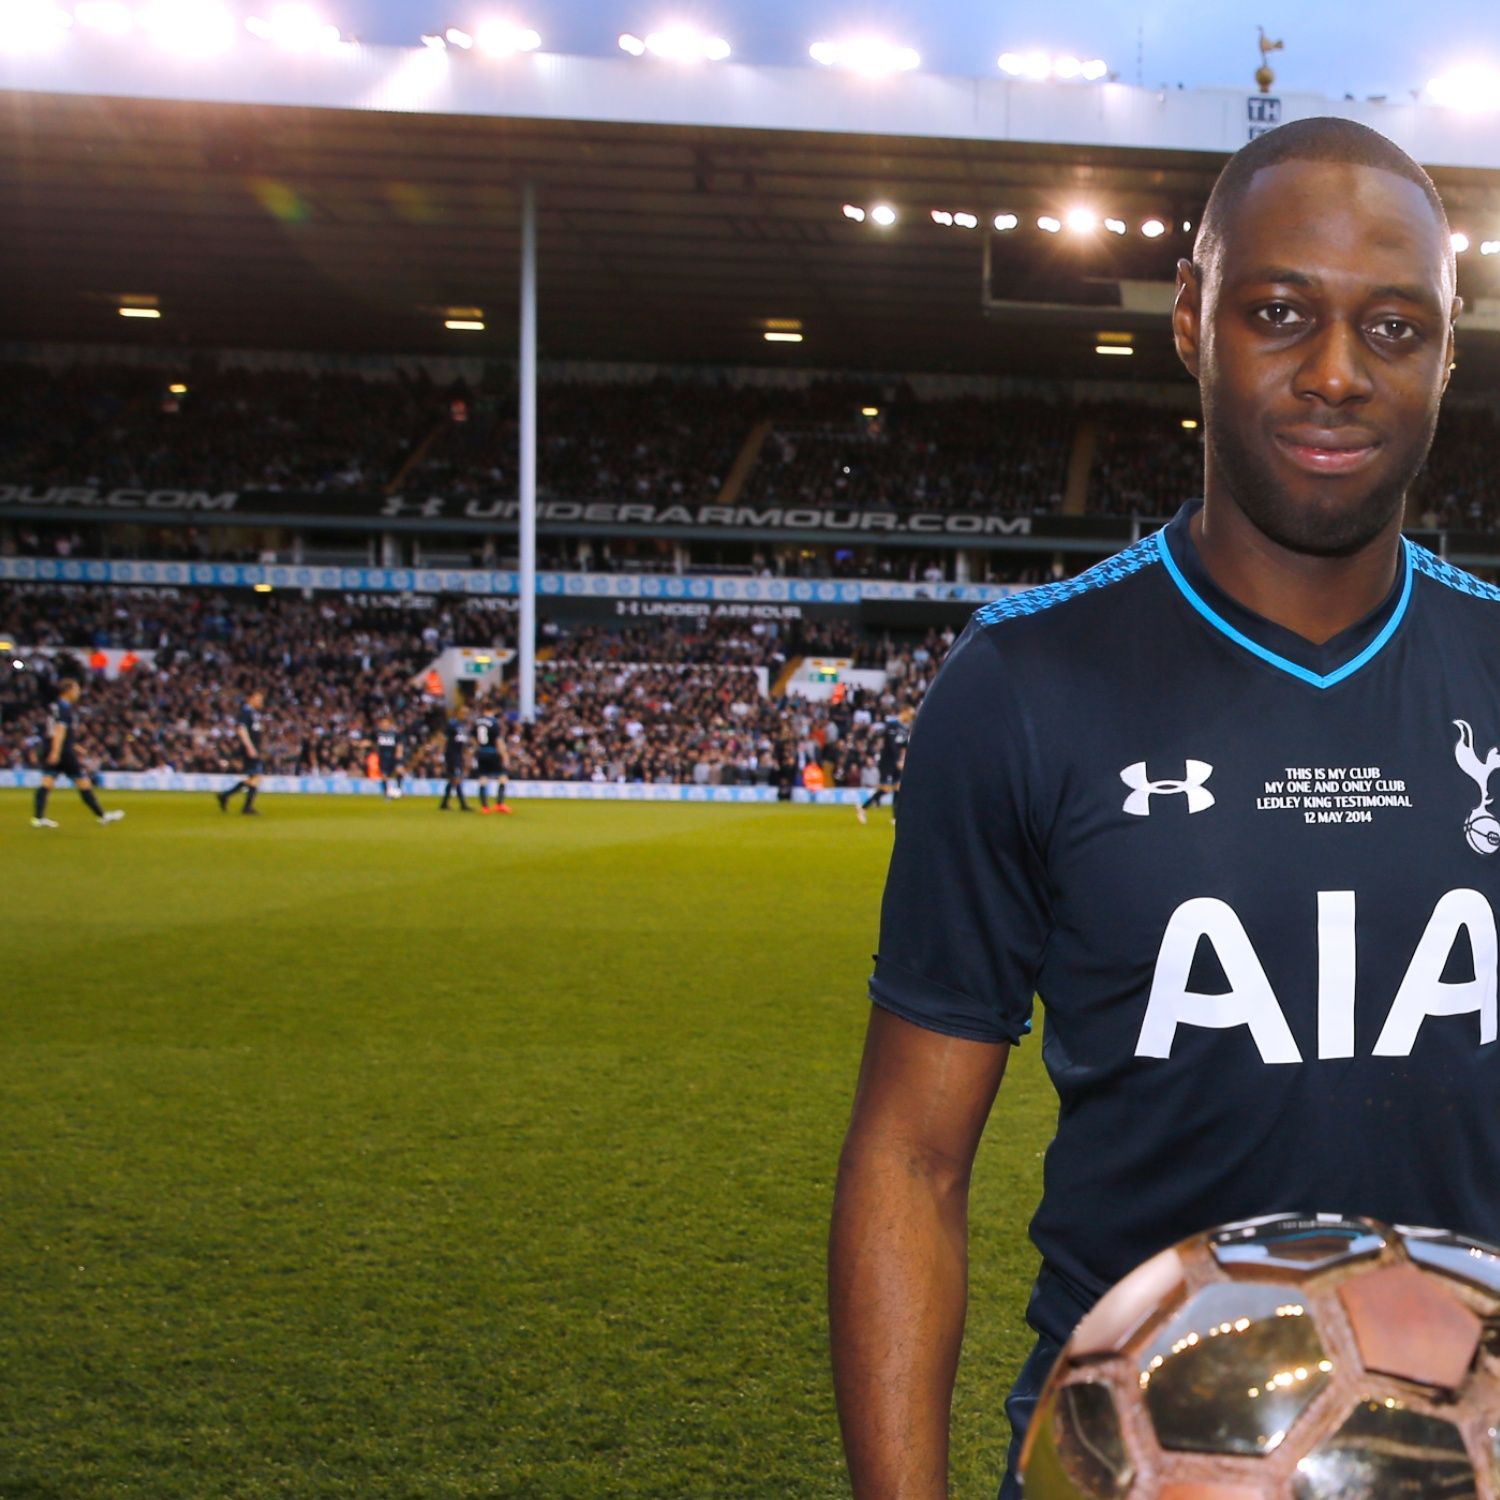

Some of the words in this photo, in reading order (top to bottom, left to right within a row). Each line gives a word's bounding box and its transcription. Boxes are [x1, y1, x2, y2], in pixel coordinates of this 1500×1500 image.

[1250, 99, 1281, 120] TH
[642, 603, 710, 617] UNDER
[714, 604, 801, 619] ARMOUR
[1285, 768, 1312, 780] THIS
[1314, 768, 1326, 779] IS
[1328, 768, 1346, 779] MY
[1350, 767, 1381, 779] CLUB
[1265, 782, 1284, 793] MY
[1287, 781, 1312, 793] ONE
[1314, 781, 1340, 793] AND
[1342, 780, 1372, 792] ONLY
[1375, 780, 1406, 791] CLUB
[1257, 797, 1300, 809] LEDLEY
[1304, 796, 1332, 808] KING
[1334, 795, 1413, 808] TESTIMONIAL
[1304, 812, 1316, 823] 12
[1318, 811, 1344, 823] MAY
[1345, 811, 1373, 823] 2014
[1134, 888, 1499, 1064] AIA
